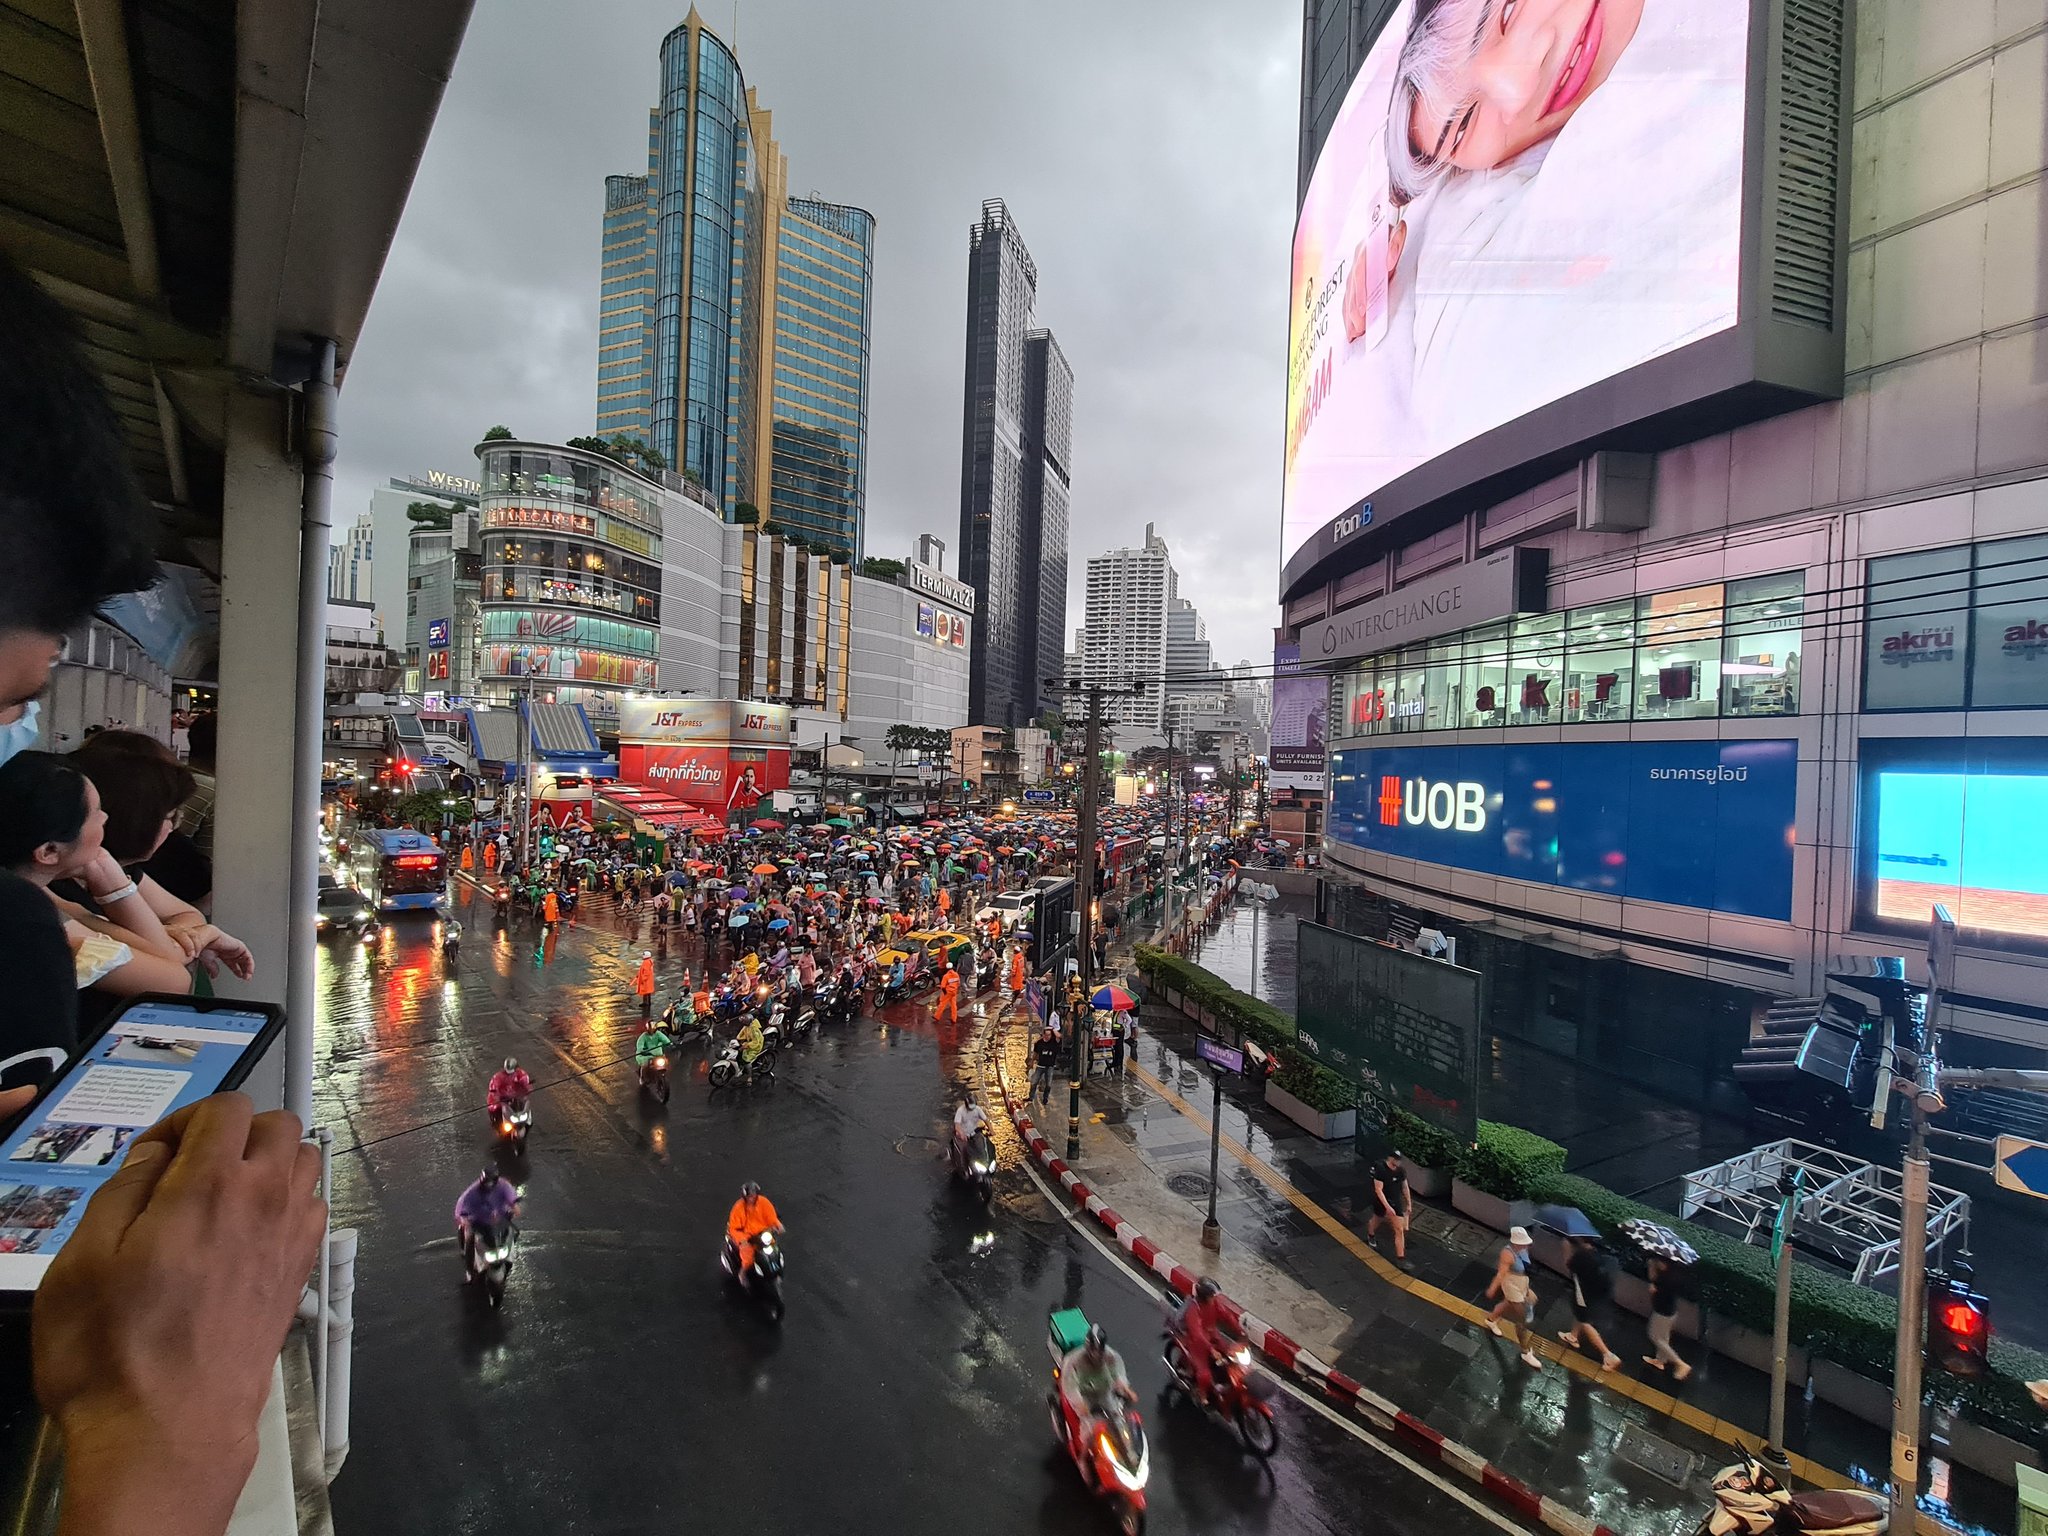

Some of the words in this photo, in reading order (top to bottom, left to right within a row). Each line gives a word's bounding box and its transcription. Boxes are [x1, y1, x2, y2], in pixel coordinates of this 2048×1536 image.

[1310, 259, 1346, 333] FOREST
[1333, 513, 1360, 543] Plan
[914, 564, 964, 605] TERMINAL
[1340, 585, 1462, 645] INTERCHANGE
[651, 712, 683, 727] J&T
[1388, 695, 1425, 719] Dental
[740, 713, 767, 730] J&T
[648, 758, 722, 784] ส่งทุกที่ทั่วไทย
[1650, 765, 1748, 785] ธนาคารยูโอบี
[1404, 778, 1487, 833] UOB
[1904, 1449, 1915, 1462] 6
